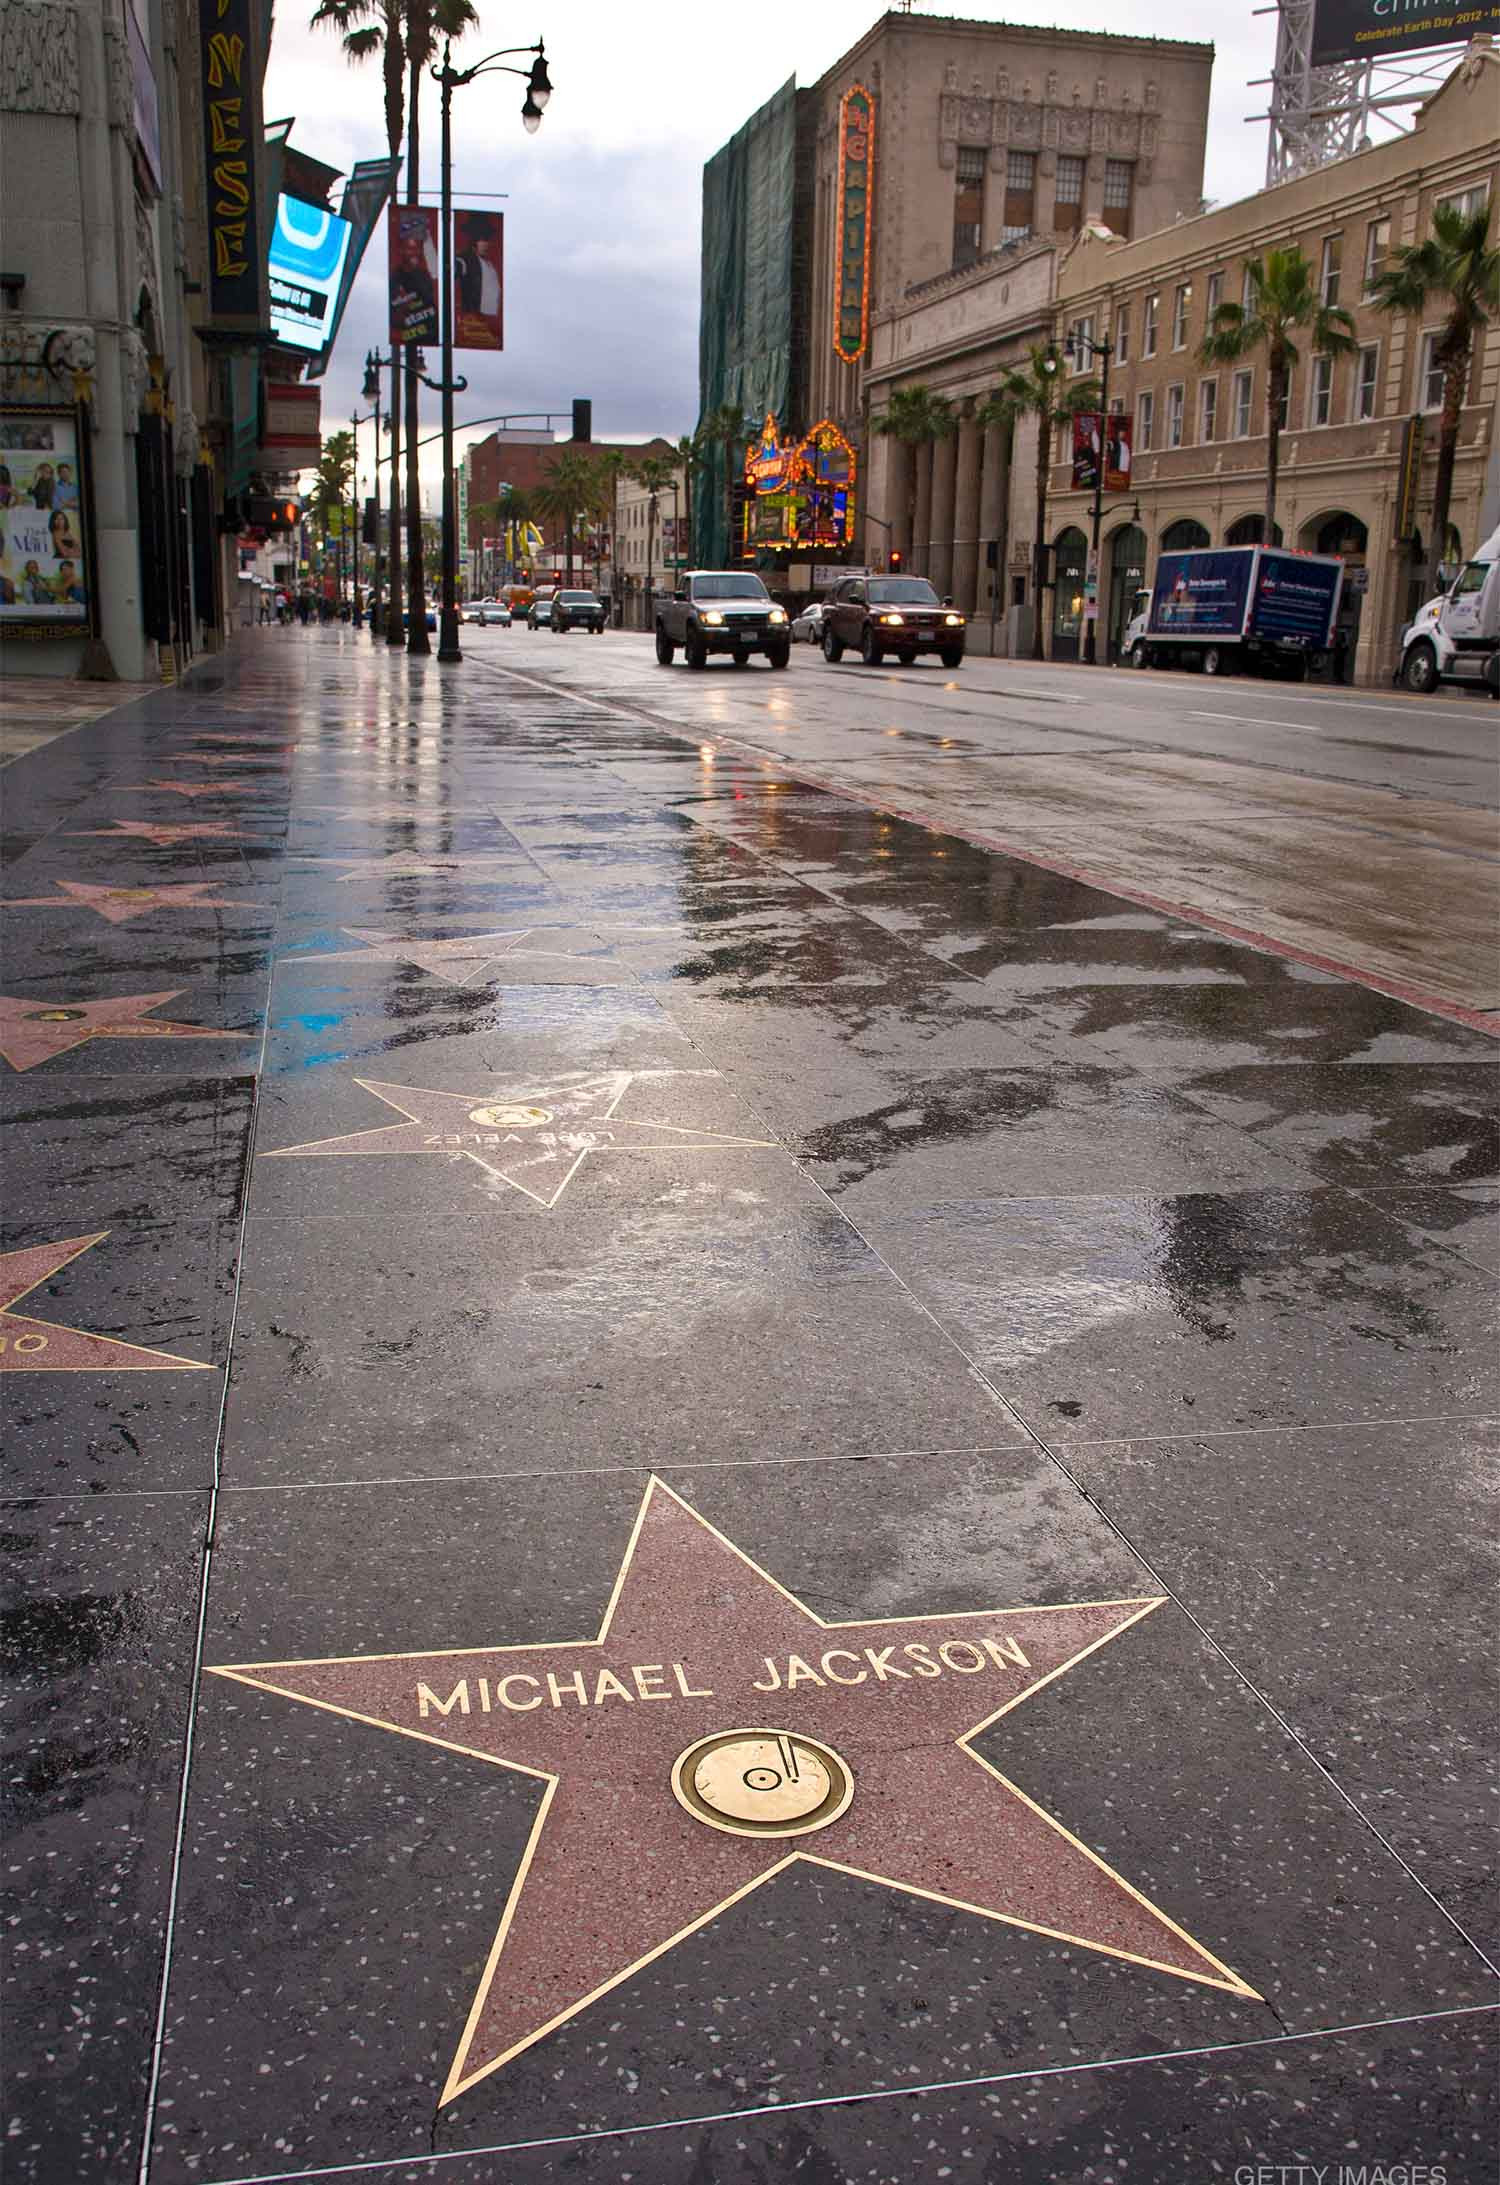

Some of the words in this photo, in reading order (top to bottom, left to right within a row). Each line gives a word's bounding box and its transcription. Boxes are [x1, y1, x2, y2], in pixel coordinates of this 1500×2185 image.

[1354, 26, 1403, 42] Celebrate
[1404, 19, 1432, 33] Earth
[1433, 16, 1454, 29] Day
[1456, 10, 1482, 25] 2012
[423, 1133, 523, 1145] VELEZ
[416, 1662, 713, 1718] MICHAEL
[752, 1635, 1033, 1692] JACKSON
